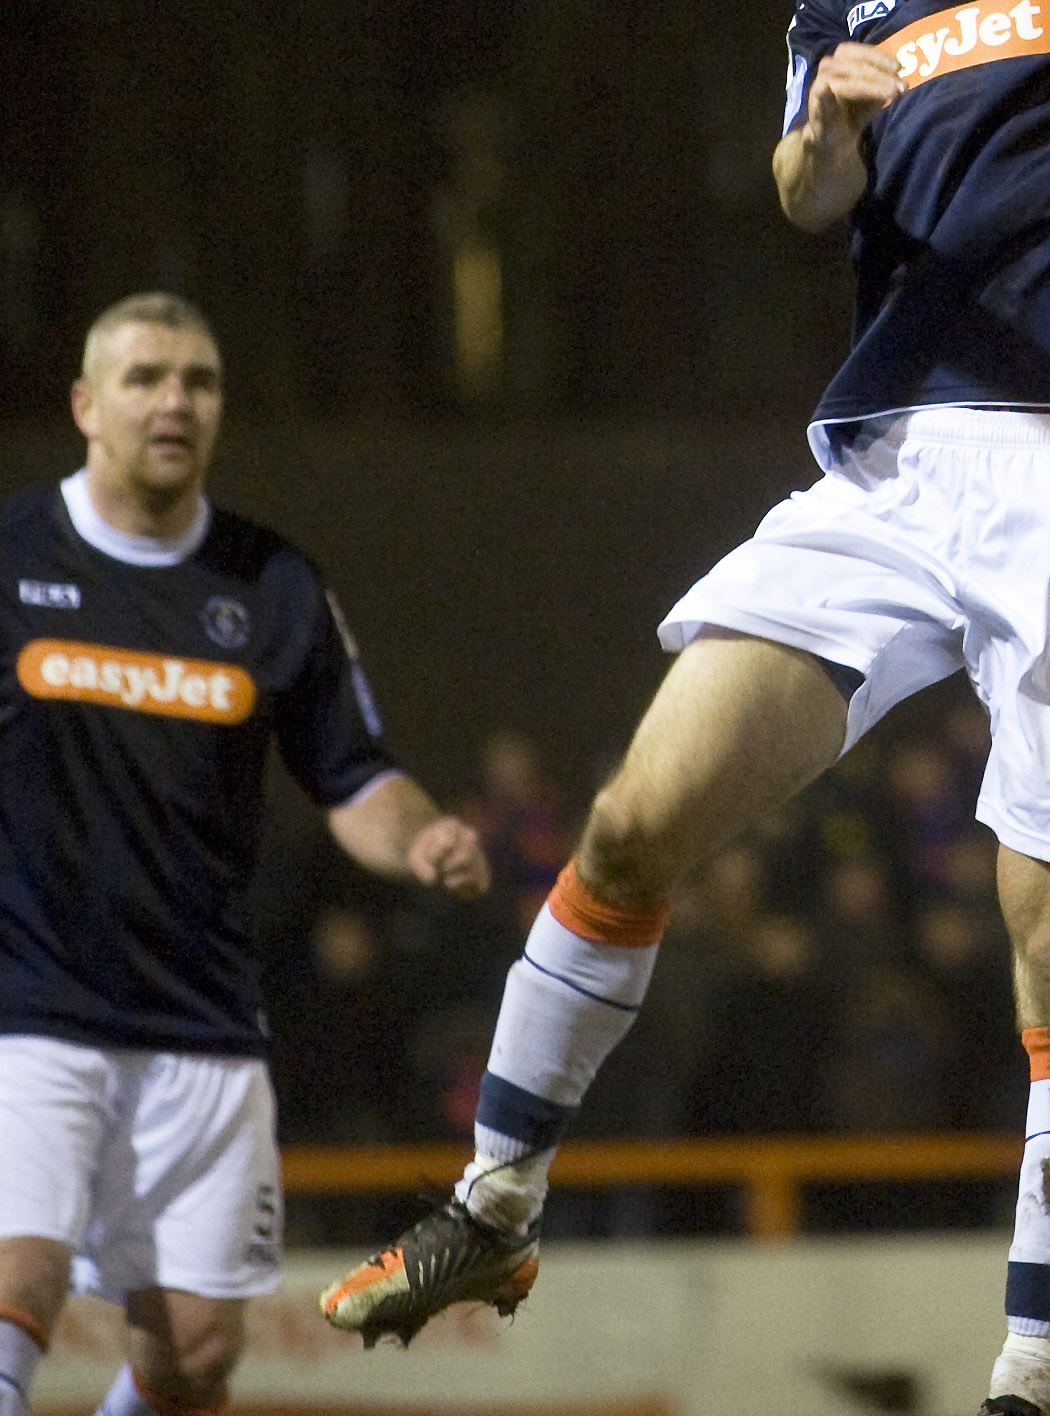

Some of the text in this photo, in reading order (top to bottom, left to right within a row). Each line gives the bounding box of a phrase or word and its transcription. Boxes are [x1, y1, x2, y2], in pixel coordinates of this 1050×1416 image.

[849, 1, 890, 29] FILA
[896, 0, 1043, 78] syJet
[40, 653, 231, 711] easyJet
